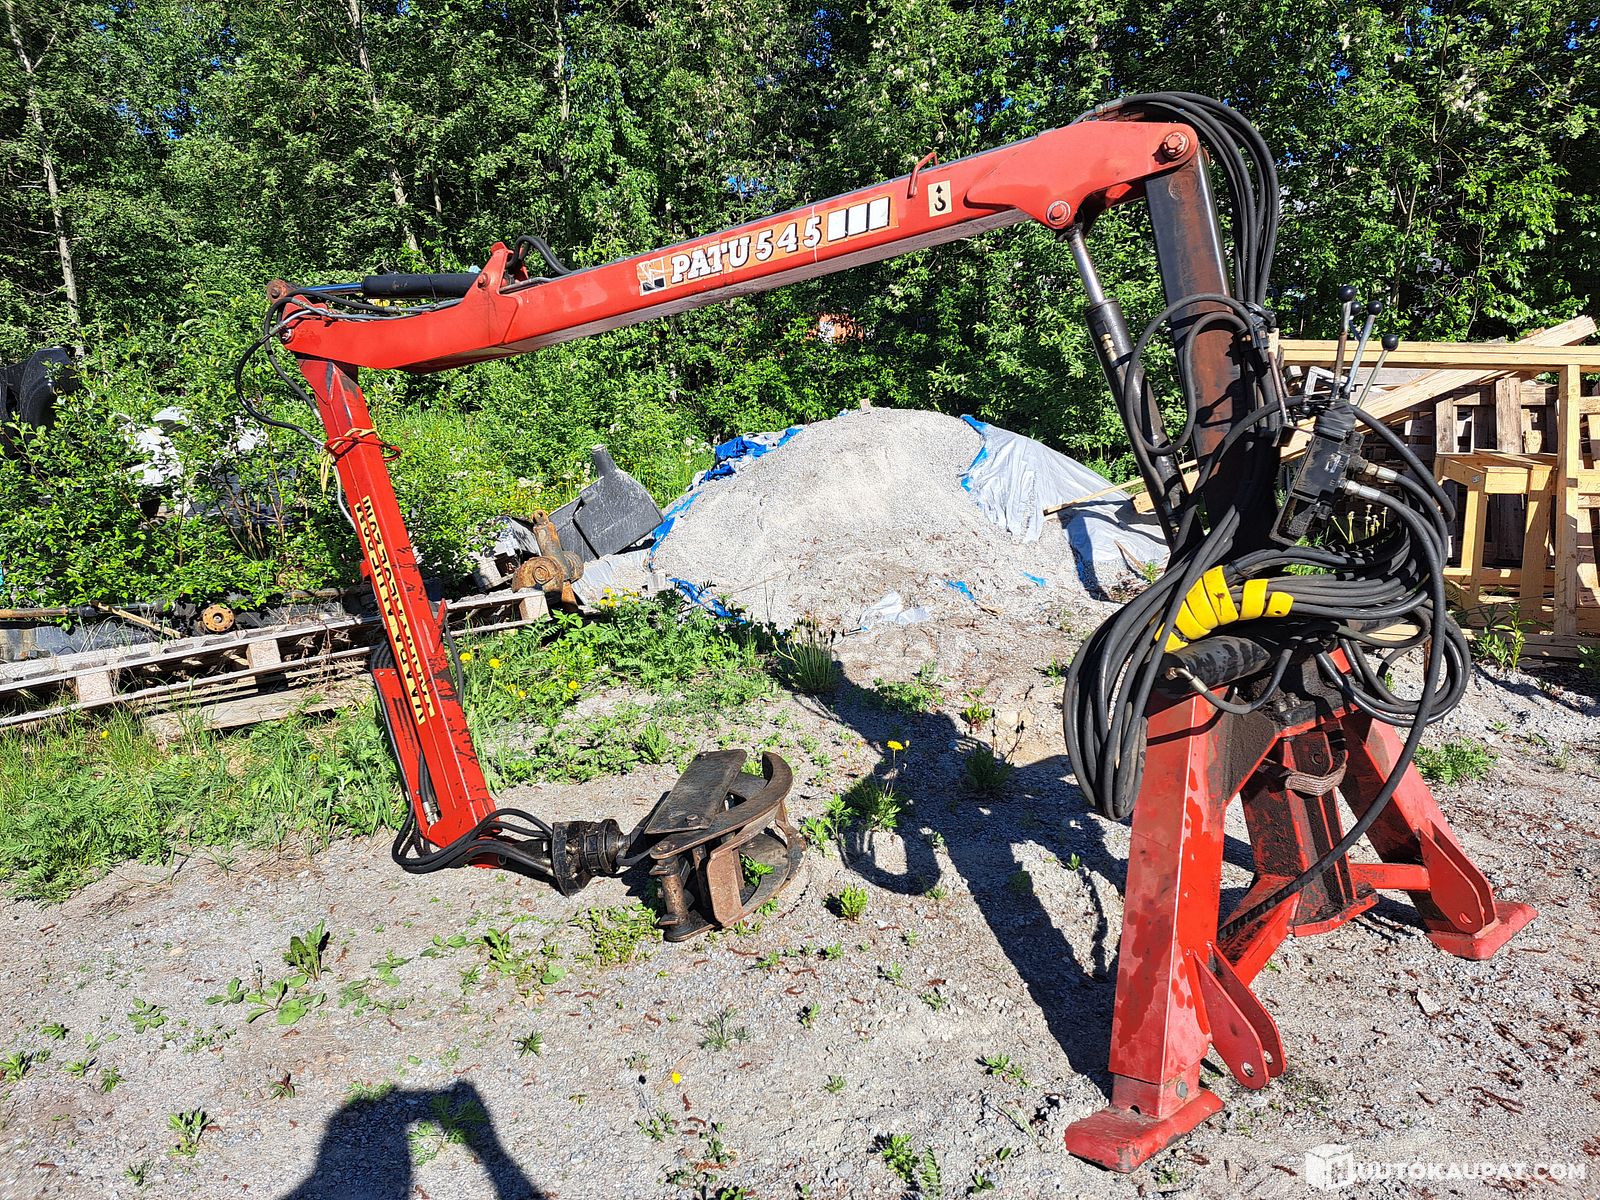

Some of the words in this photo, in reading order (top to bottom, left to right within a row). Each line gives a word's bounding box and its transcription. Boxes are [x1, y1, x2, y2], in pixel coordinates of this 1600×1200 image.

[671, 236, 751, 284] PATU
[755, 216, 821, 261] 545
[369, 548, 433, 720] VAARAALUE
